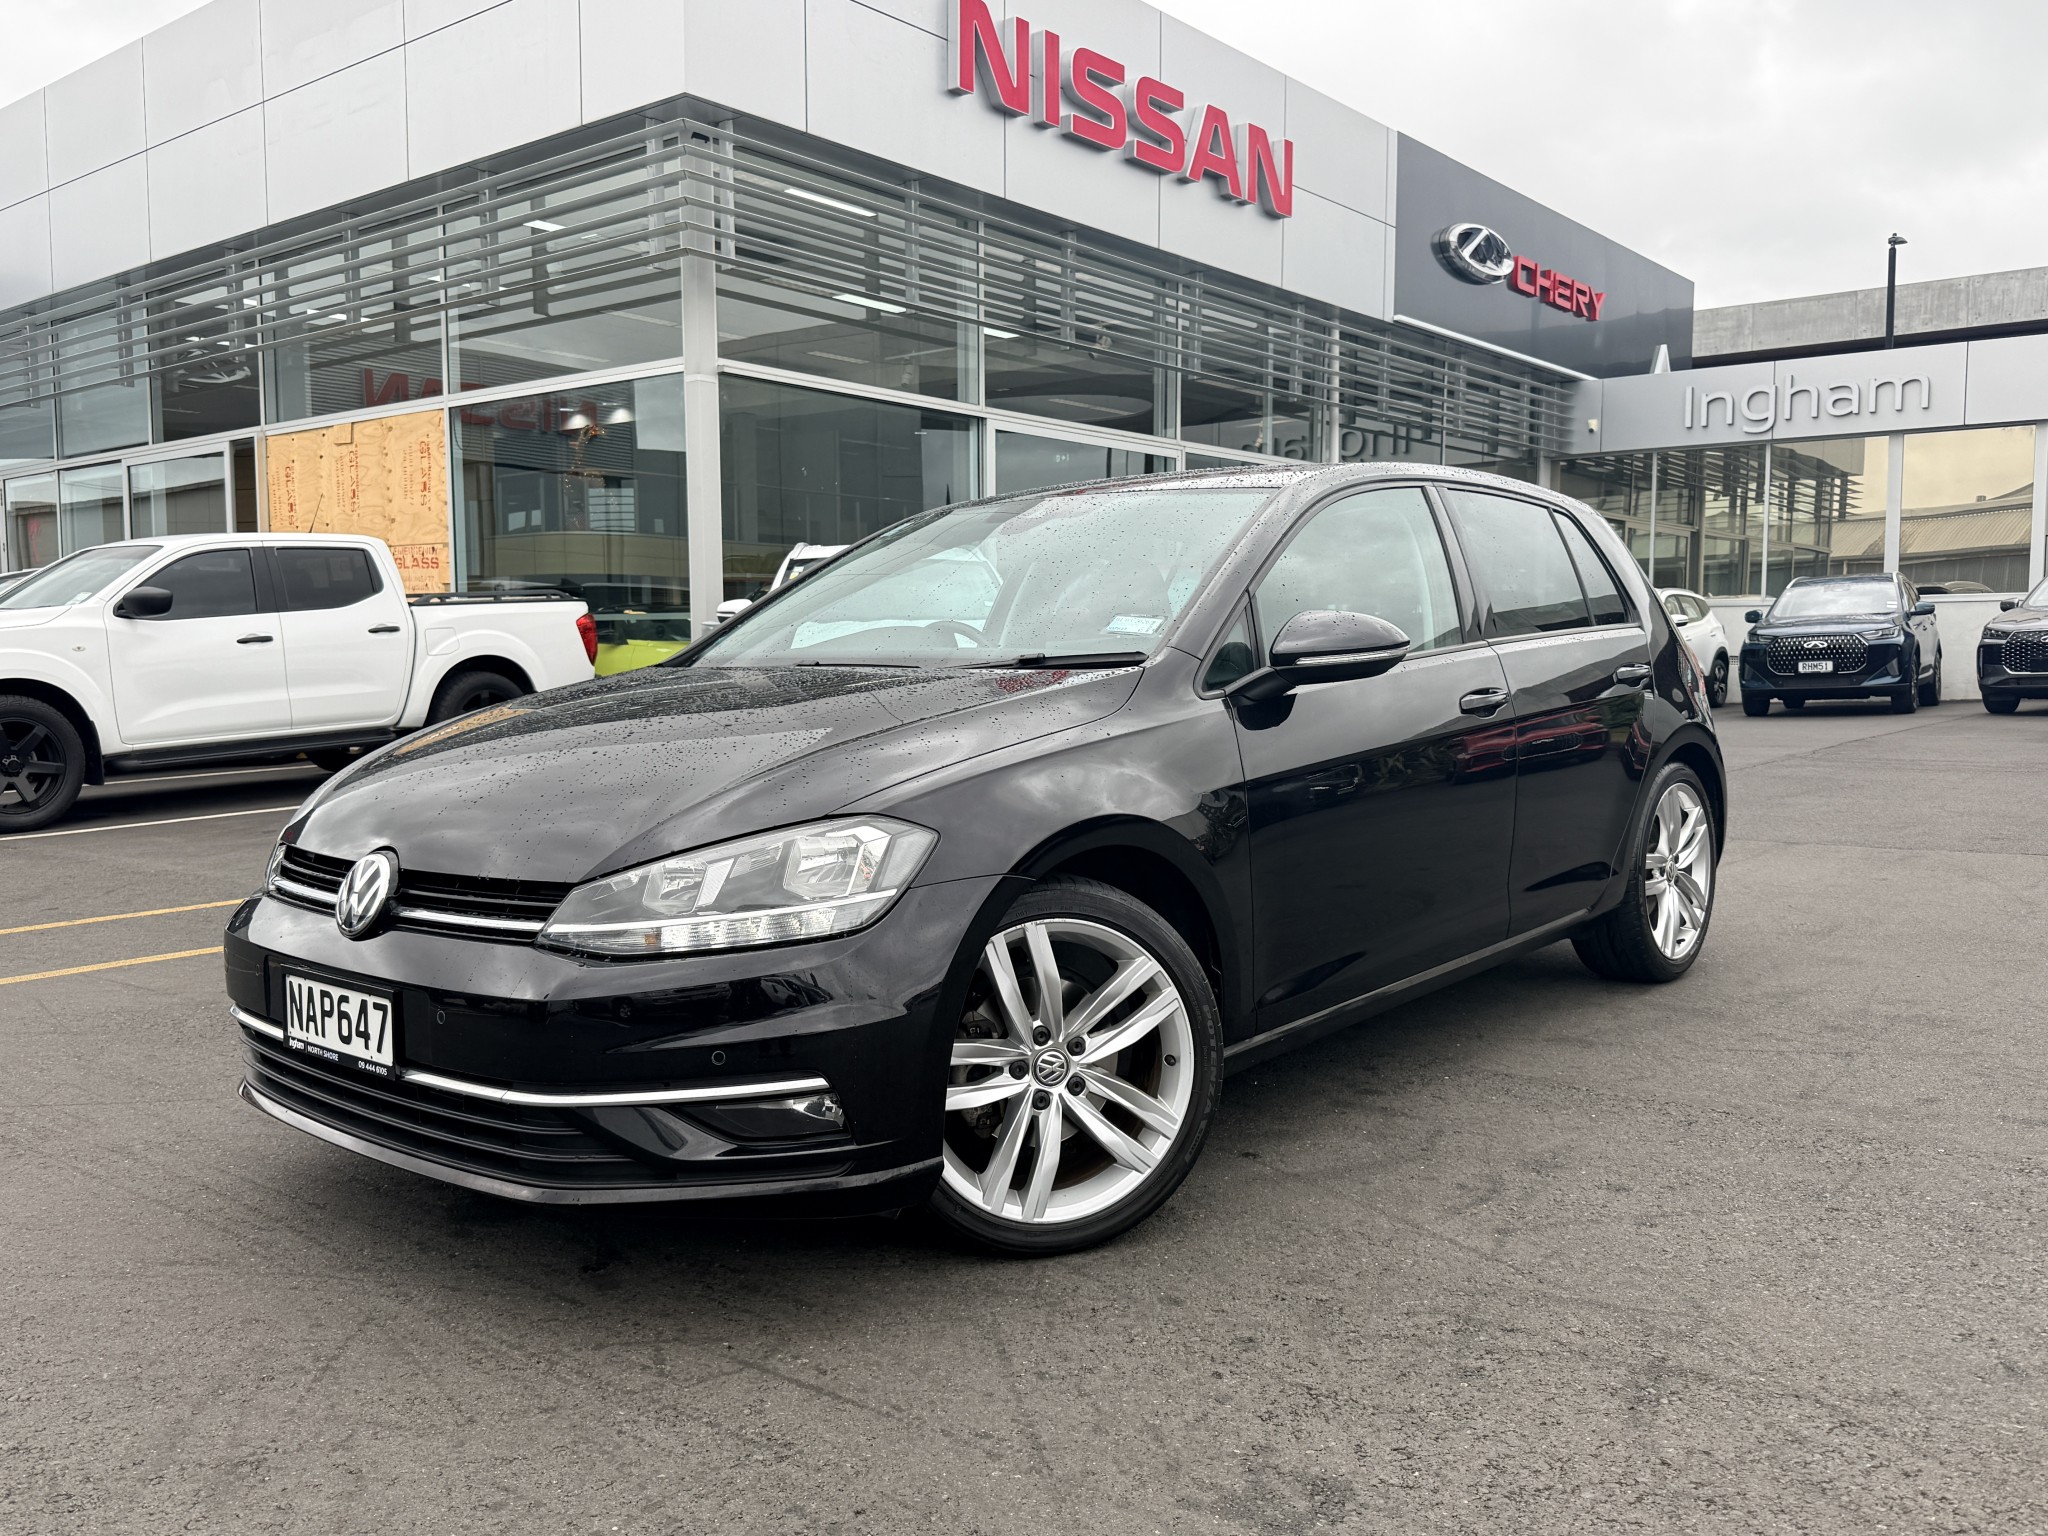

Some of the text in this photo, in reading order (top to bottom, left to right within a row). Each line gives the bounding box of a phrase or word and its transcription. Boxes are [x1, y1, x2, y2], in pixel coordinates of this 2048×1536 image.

[950, 0, 1294, 219] NISSAN
[1509, 254, 1606, 322] CHERY
[1684, 373, 1931, 435] Ingham
[394, 556, 440, 570] GLASS
[1802, 662, 1828, 671] RHM51
[288, 980, 389, 1055] NAP647
[289, 1036, 305, 1050] Ingham
[307, 1045, 339, 1062] NORTH SHORE
[1201, 1003, 1217, 1114] POTENZA
[358, 1060, 388, 1076] 09 444 6105
